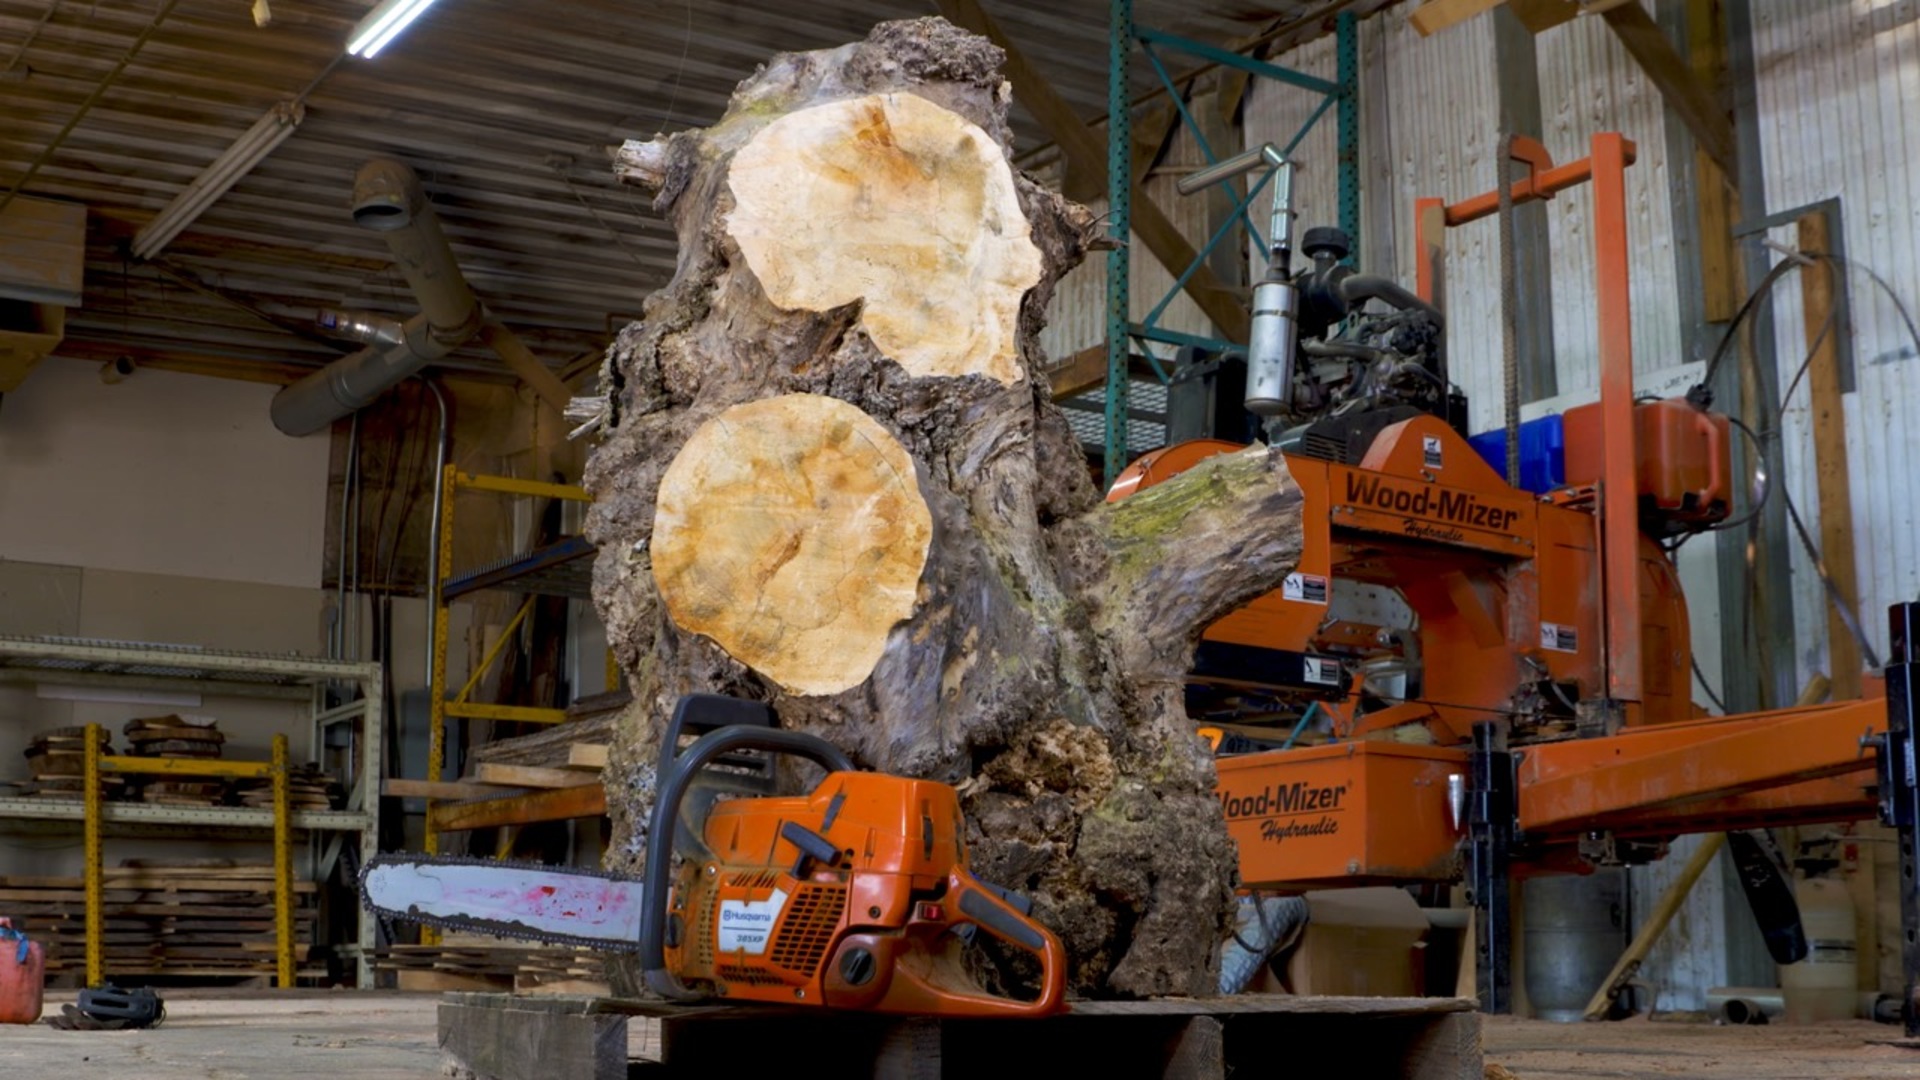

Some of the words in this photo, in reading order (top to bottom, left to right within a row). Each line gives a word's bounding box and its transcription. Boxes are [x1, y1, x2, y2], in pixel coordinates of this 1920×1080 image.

[1346, 471, 1518, 531] Wood-Mizer
[1403, 518, 1464, 542] Hydraulic
[1261, 816, 1338, 844] Hydraulic
[731, 911, 772, 922] Husqvarna
